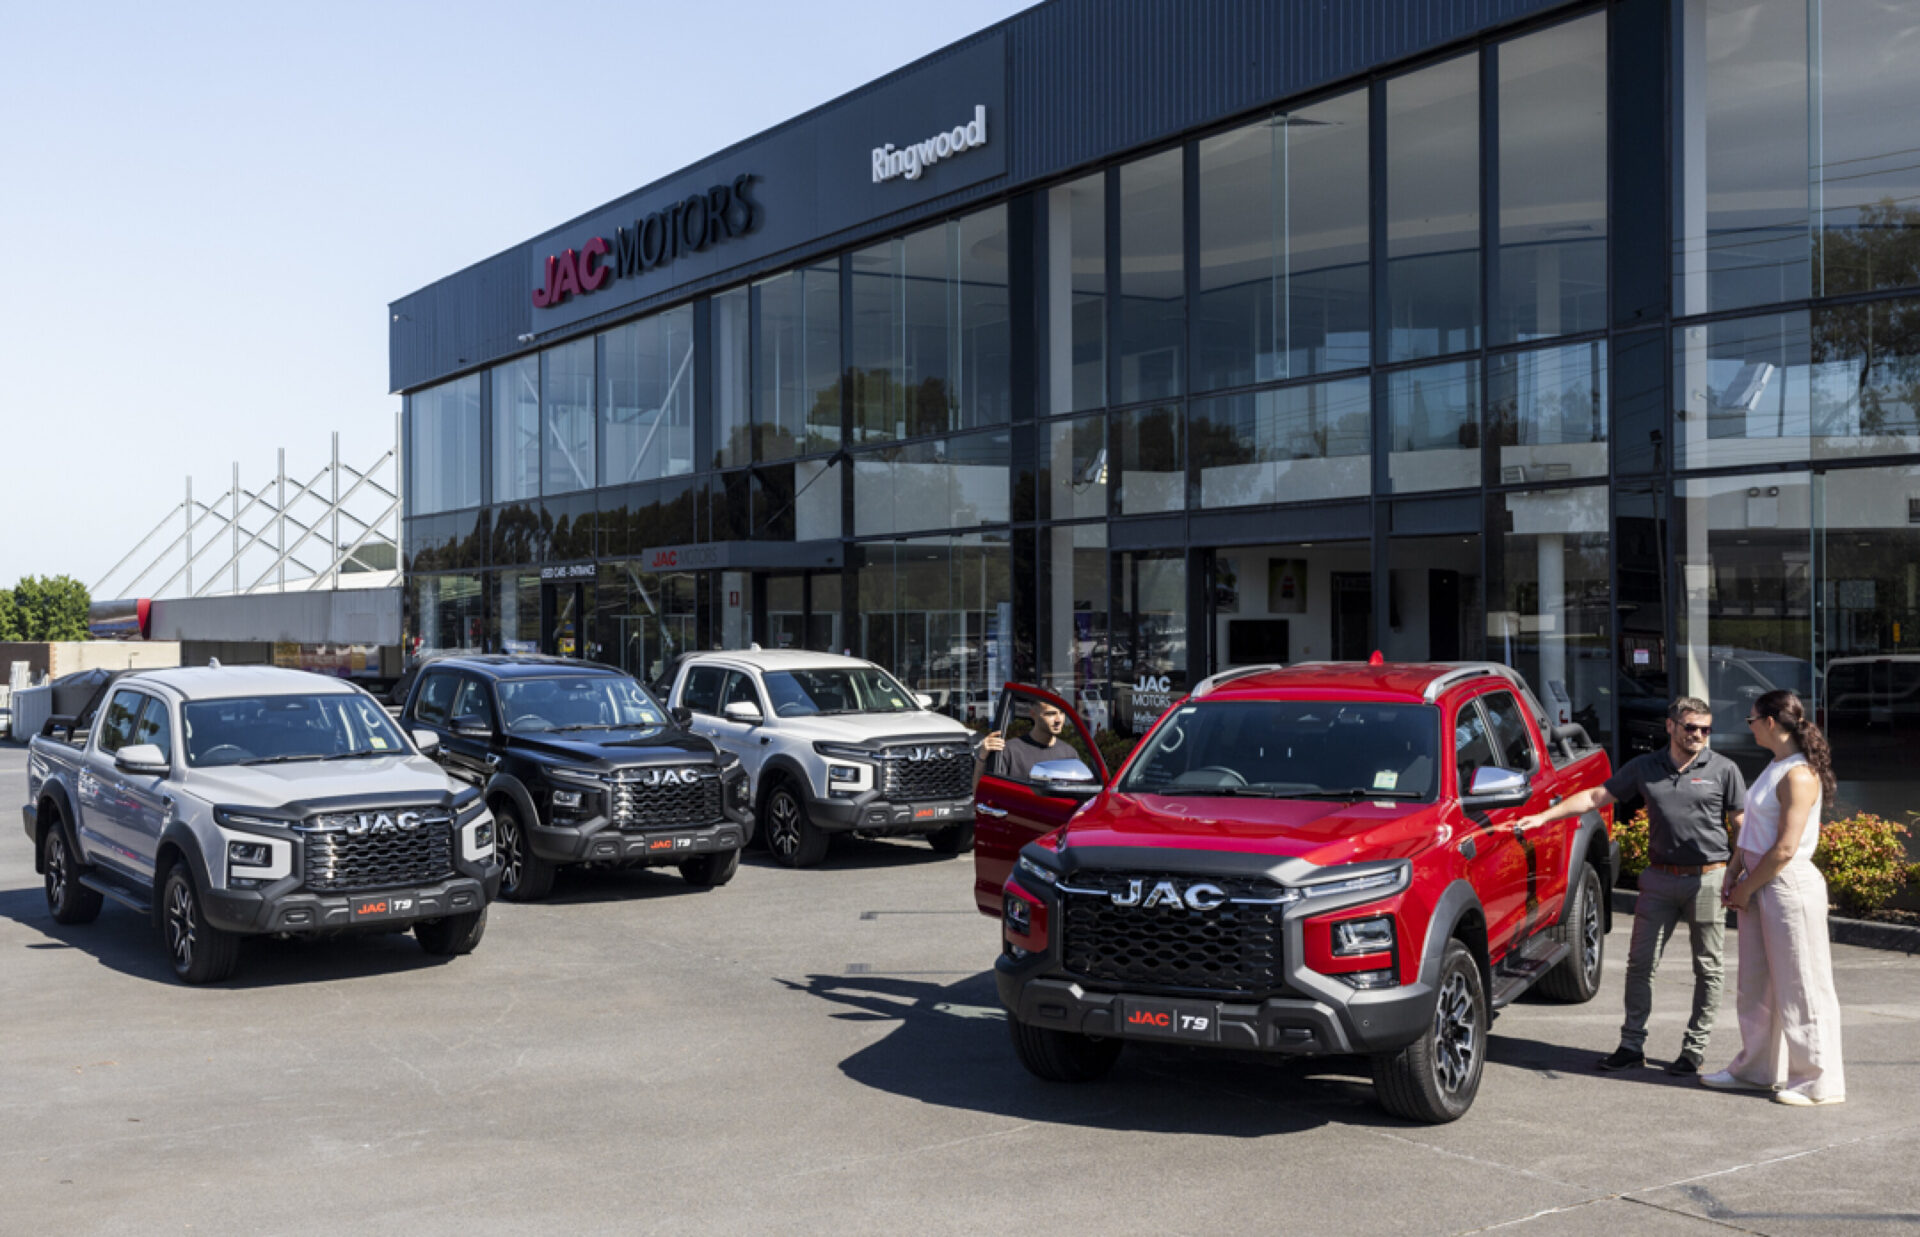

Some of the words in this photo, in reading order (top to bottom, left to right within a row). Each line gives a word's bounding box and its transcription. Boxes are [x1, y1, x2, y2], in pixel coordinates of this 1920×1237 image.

[872, 104, 986, 183] Ringwood
[532, 237, 610, 308] JAC
[614, 173, 760, 280] MOTORS
[652, 549, 678, 568] JAC
[680, 546, 718, 566] MOTORS
[1133, 675, 1171, 693] JAC
[1131, 693, 1171, 708] MOTORS
[907, 747, 954, 762] JAC
[643, 768, 698, 787] JAC
[346, 811, 421, 835] JAC
[649, 839, 673, 850] JAC
[1110, 879, 1226, 911] JAC
[357, 902, 387, 915] JAC
[393, 899, 413, 911] T9
[1127, 1010, 1170, 1027] JAC
[1180, 1015, 1210, 1030] T9
